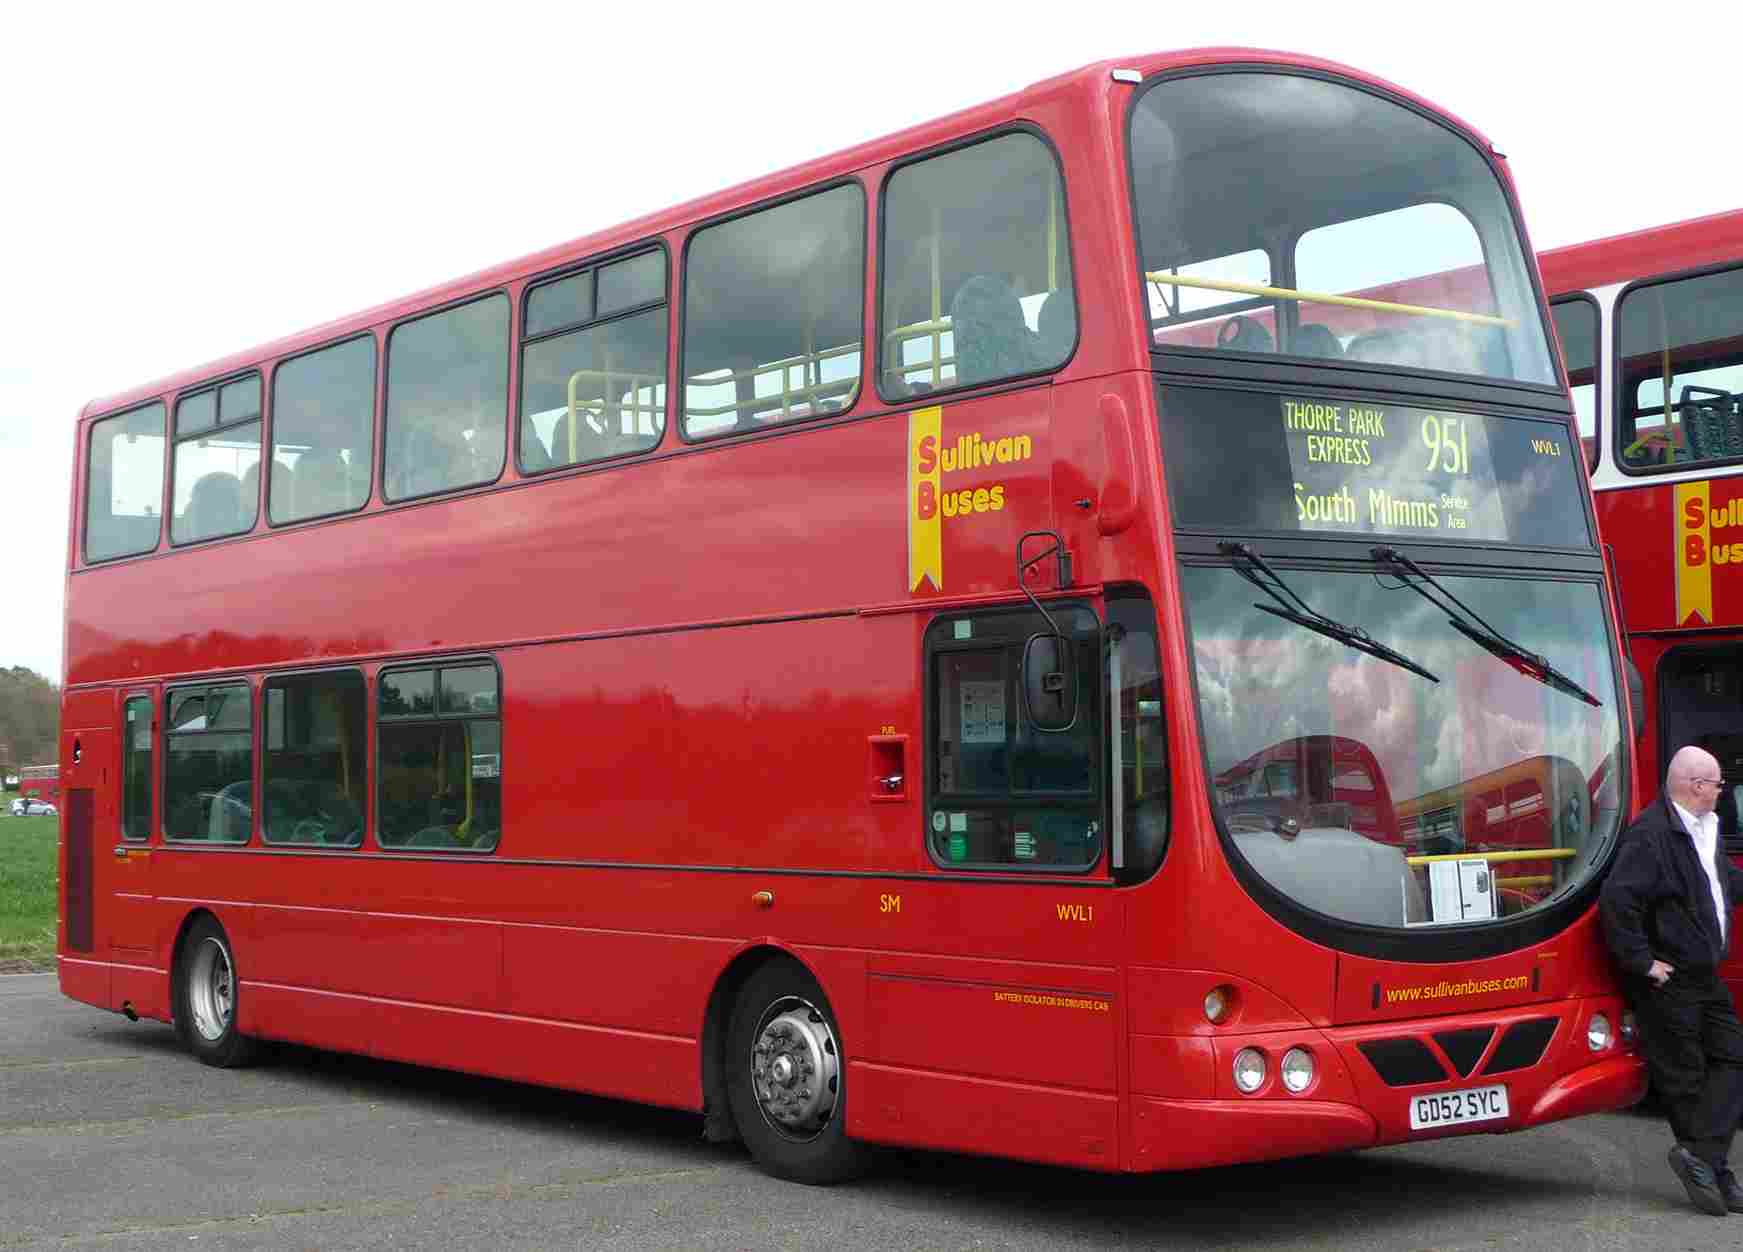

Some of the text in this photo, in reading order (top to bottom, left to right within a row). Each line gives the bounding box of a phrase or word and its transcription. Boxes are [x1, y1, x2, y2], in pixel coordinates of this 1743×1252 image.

[1285, 402, 1385, 438] THORPE PARK
[918, 432, 1033, 475] Sullivan
[1307, 434, 1371, 466] EXPRESS
[1421, 413, 1470, 474] 951
[918, 480, 1006, 520] Buses
[1293, 482, 1357, 524] South
[879, 894, 901, 914] SM
[1056, 903, 1094, 922] WVL1
[1386, 975, 1528, 1001] www.sullivanbuses.com
[1417, 1090, 1501, 1123] GD52 SYC
